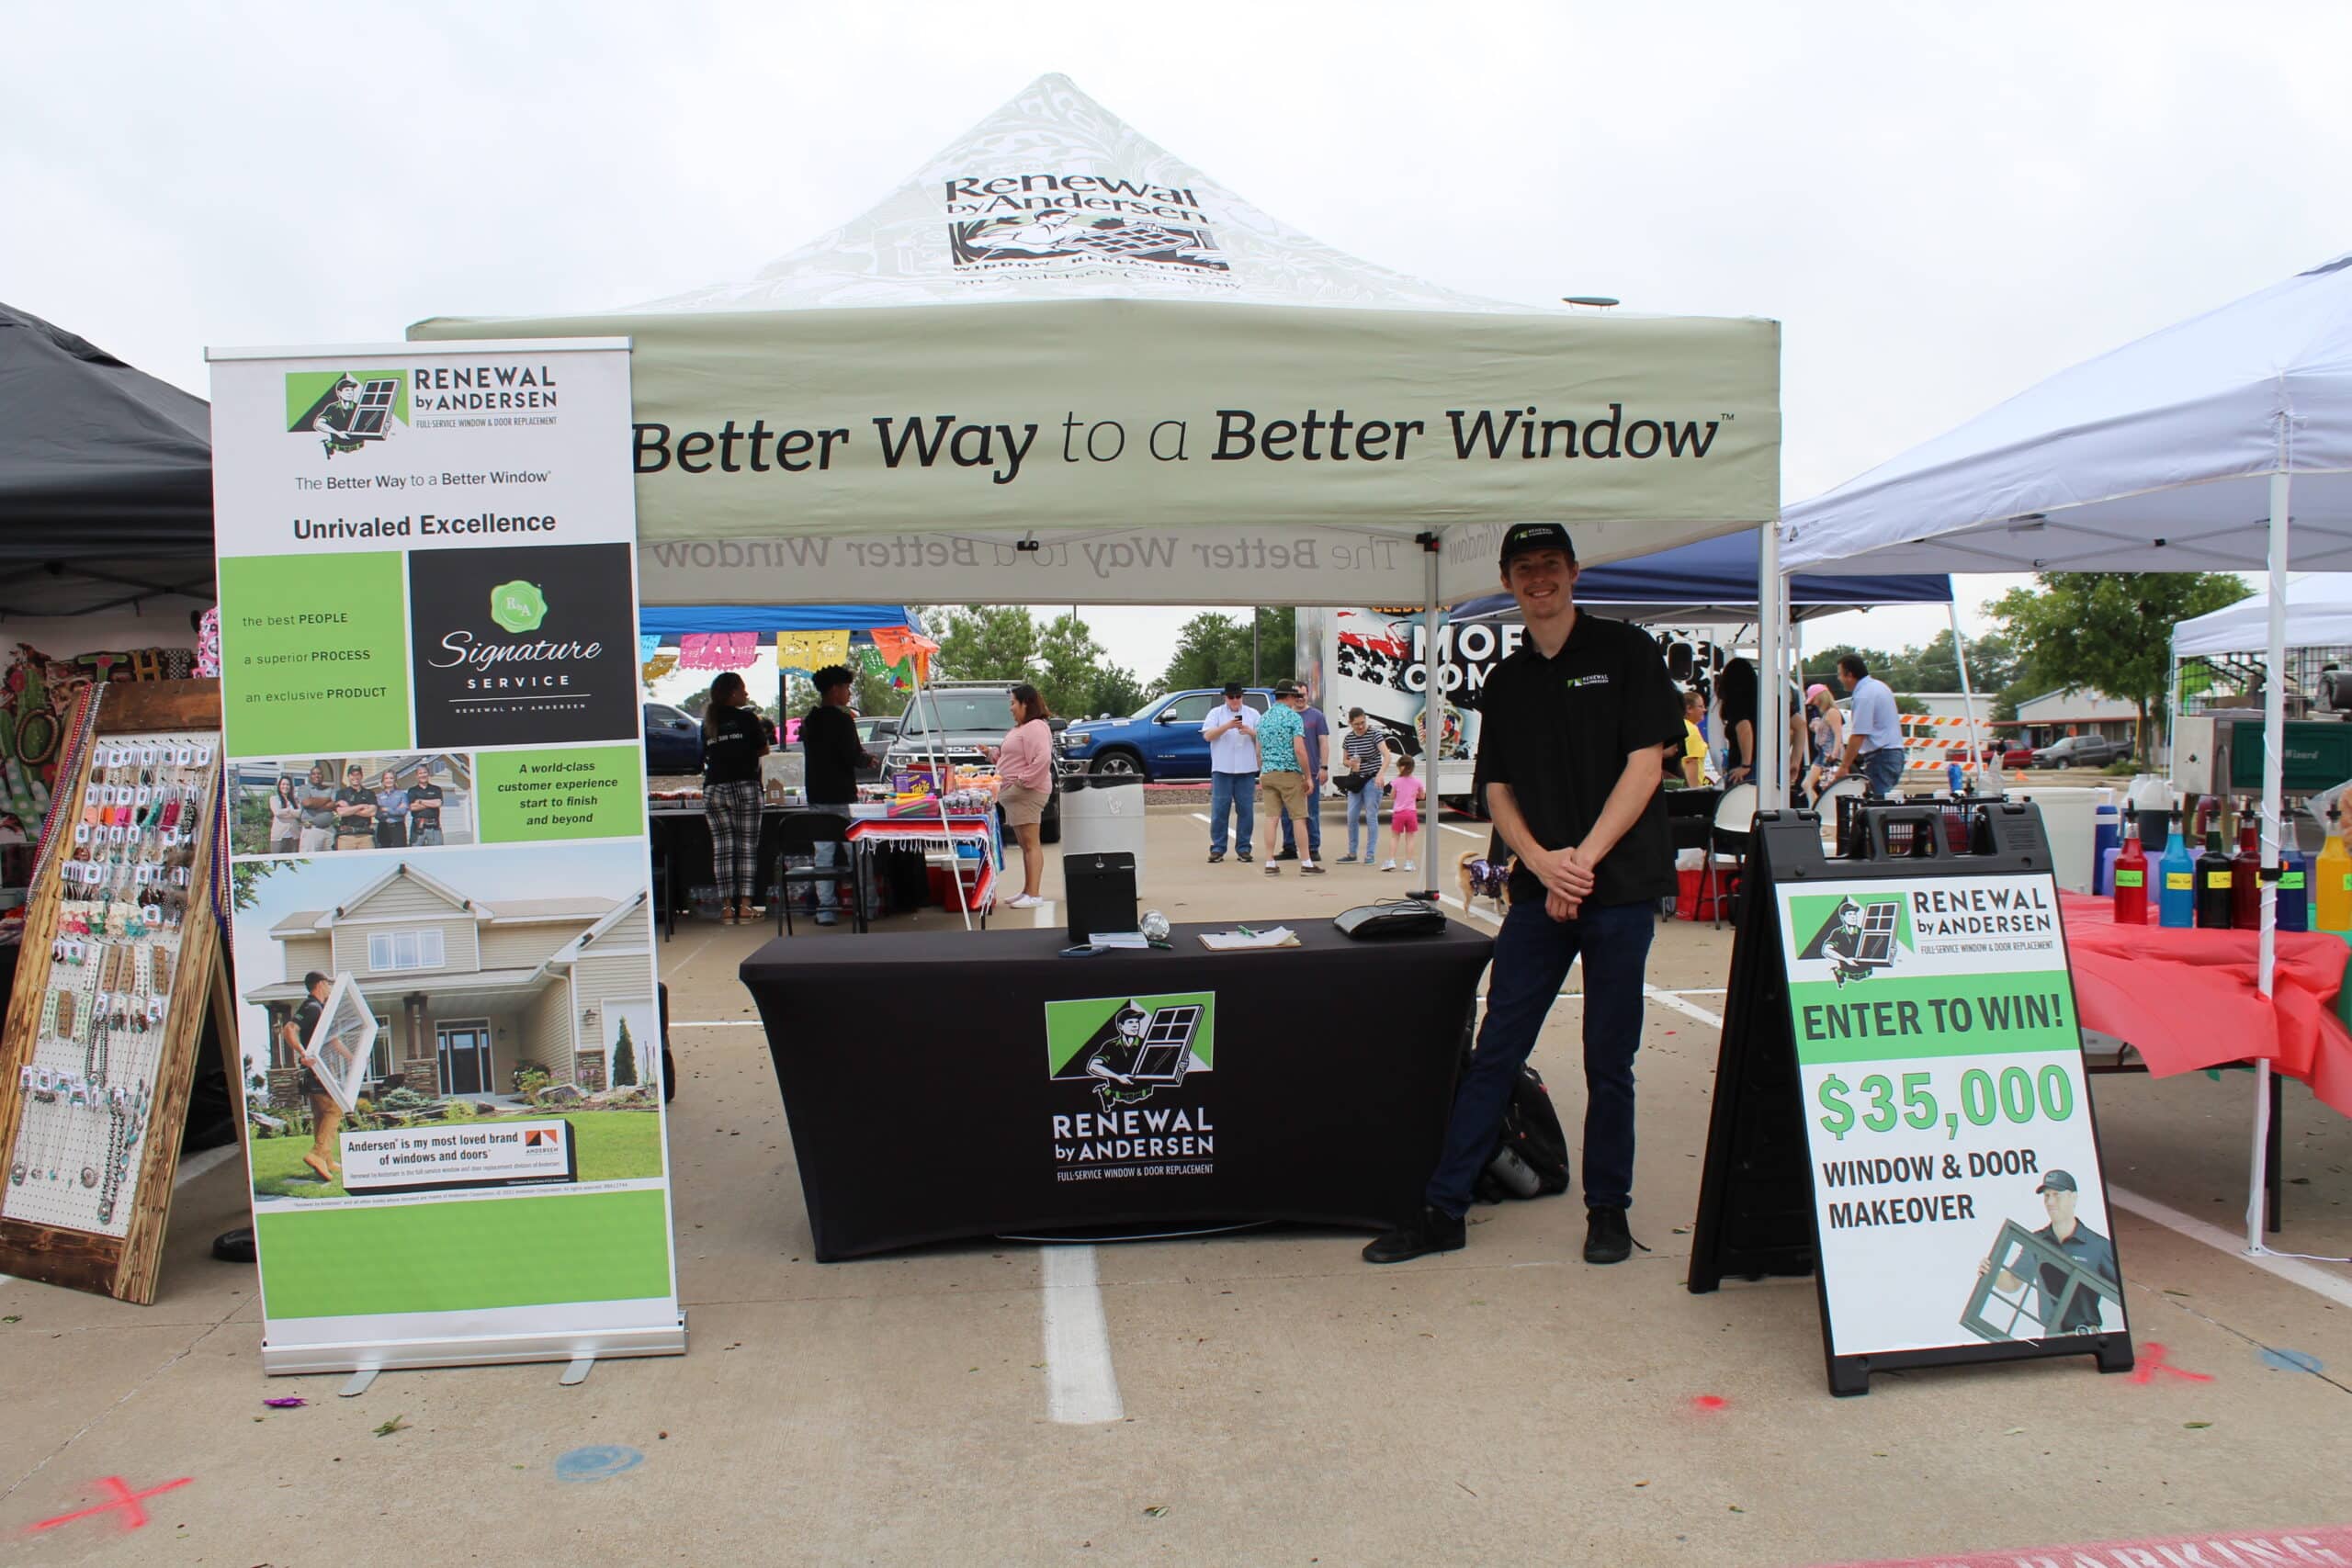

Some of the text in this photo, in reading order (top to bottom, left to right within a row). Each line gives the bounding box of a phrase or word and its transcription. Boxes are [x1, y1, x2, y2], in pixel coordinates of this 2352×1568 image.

[945, 175, 1199, 208] Renewal
[947, 192, 1209, 225] by Andersen
[415, 366, 557, 390] RENEWAL
[416, 390, 558, 412] by ANDERSEN
[416, 415, 557, 429] FULL-SERVICE WINDOW & DOOR REPLACEMENT
[632, 420, 849, 473] Better
[873, 415, 1038, 484] Way
[1061, 411, 1125, 462] to
[1149, 420, 1189, 462] a
[1212, 408, 1425, 460] Better
[295, 476, 322, 491] The
[327, 474, 371, 490] Better
[376, 474, 407, 491] Way
[411, 474, 424, 487] to
[429, 476, 437, 487] a
[442, 471, 486, 486] Better
[294, 513, 557, 539] Unrivaled Excellence
[243, 613, 348, 626] the best PEOPLE
[428, 630, 602, 671] Signature
[1414, 624, 1525, 660] MOB
[244, 649, 371, 668] a superior PROCESS
[467, 675, 571, 690] SERVICE
[245, 686, 387, 703] an exclusive PRODUCT
[519, 761, 596, 773] A world-class
[498, 778, 618, 793] customer experience
[520, 795, 598, 808] start to finish
[526, 813, 594, 826] and beyond
[1913, 887, 2048, 914] RENEWAL
[1917, 914, 2052, 936] by ANDERSEN
[1920, 939, 2054, 954] FULL-SERVICE WINDOW & DOOR REPLACEMENT
[1803, 993, 2064, 1041] ENTER TO WIN!
[1818, 1064, 2074, 1141] $35,000
[1053, 1107, 1214, 1139] RENEWAL
[401, 1138, 410, 1149] is
[414, 1139, 428, 1151] my
[432, 1135, 457, 1147] most
[460, 1133, 486, 1145] loved
[490, 1131, 518, 1144] brand
[1056, 1135, 1214, 1161] by ANDERSEN
[379, 1154, 390, 1166] of
[392, 1152, 435, 1164] windows
[439, 1150, 457, 1161] and
[1822, 1149, 2039, 1188] WINDOW & DOOR
[1057, 1163, 1214, 1182] FULL-SERVICE WINDOW & DOOR REPLACEMENT
[1828, 1194, 1975, 1229] MAKEOVER
